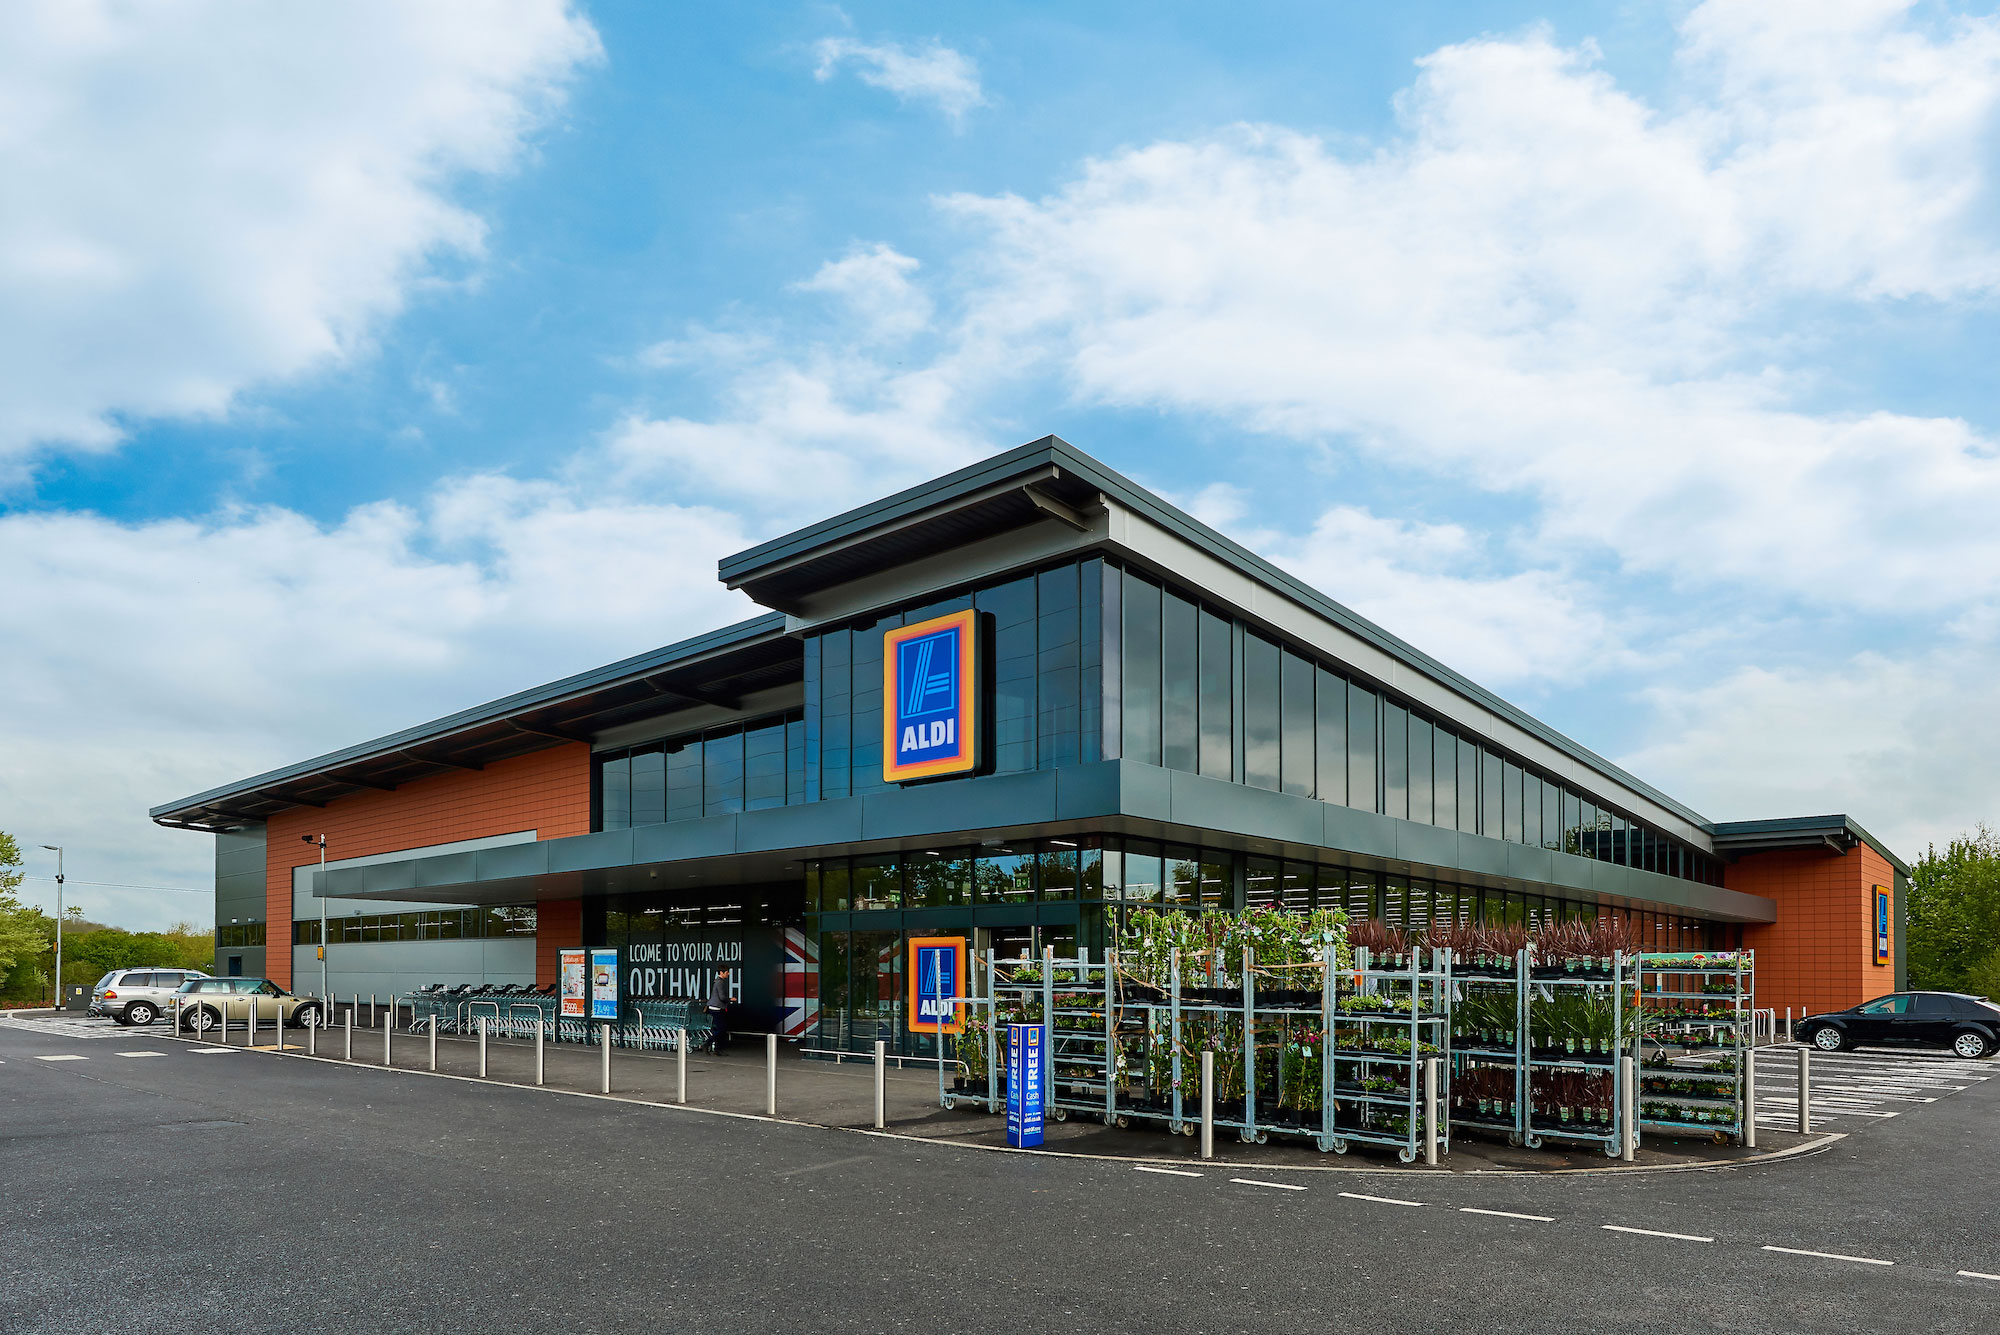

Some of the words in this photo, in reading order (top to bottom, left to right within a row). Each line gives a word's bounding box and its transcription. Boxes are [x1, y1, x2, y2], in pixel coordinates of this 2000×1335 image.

[901, 718, 955, 753] ALDI
[629, 943, 662, 962] LCOME
[666, 943, 680, 962] TO
[682, 942, 713, 962] YOUR
[716, 942, 742, 962] ALDI
[629, 967, 742, 1004] ORTHWIH
[920, 999, 953, 1016] ALDI
[1028, 1047, 1039, 1090] FREE
[1026, 1091, 1039, 1100] Cash
